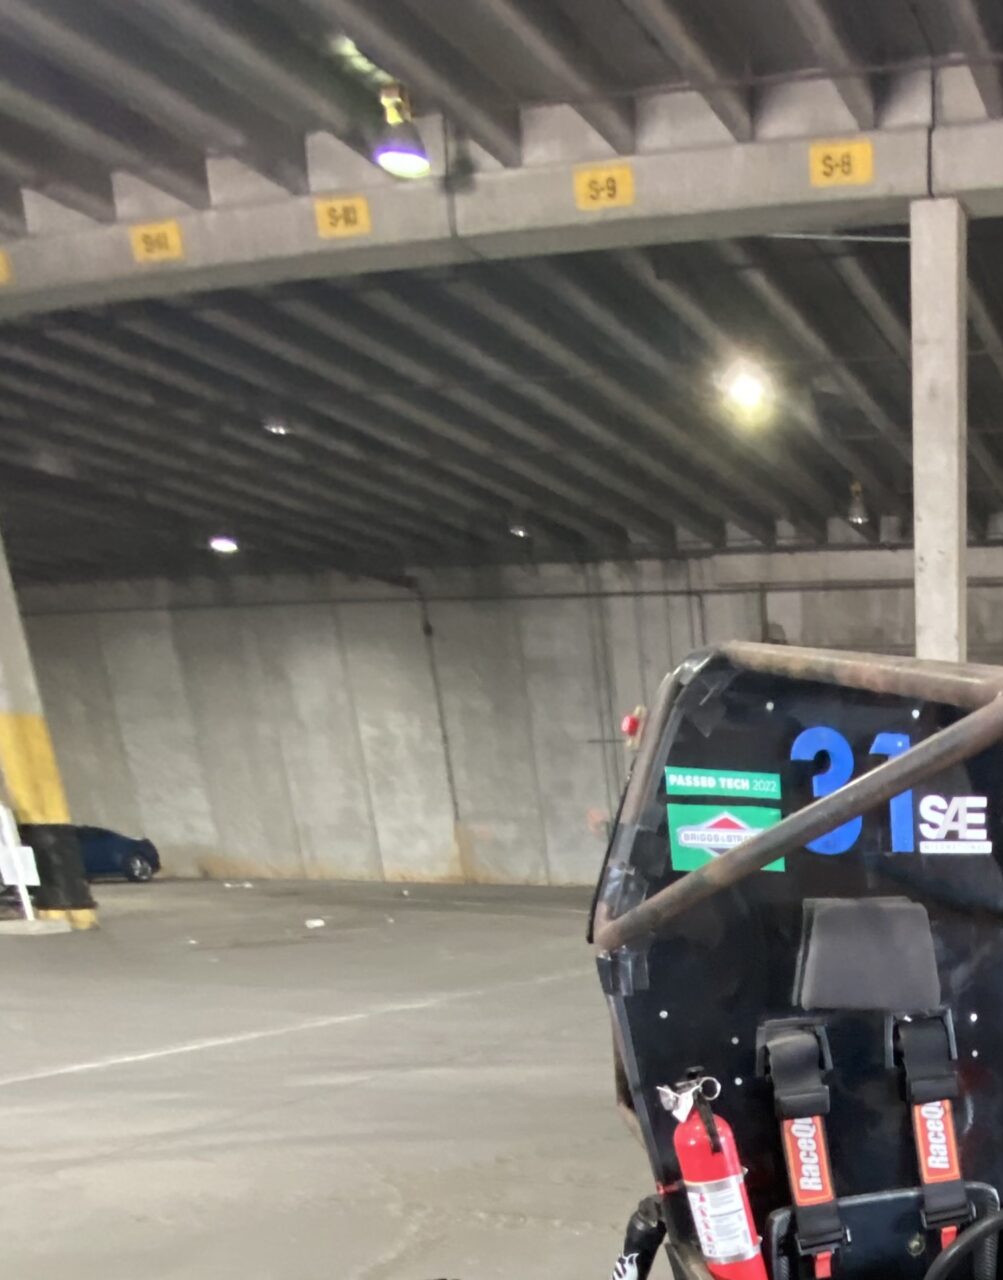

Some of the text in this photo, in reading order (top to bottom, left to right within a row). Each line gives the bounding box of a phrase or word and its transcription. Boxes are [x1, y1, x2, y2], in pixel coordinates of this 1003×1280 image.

[822, 154, 852, 178] S-8
[588, 176, 617, 201] S-9
[668, 774, 777, 792] PASSED TECH 2022
[790, 726, 914, 855] 31
[919, 795, 988, 840] SAE
[920, 1101, 950, 1169] RaceQ
